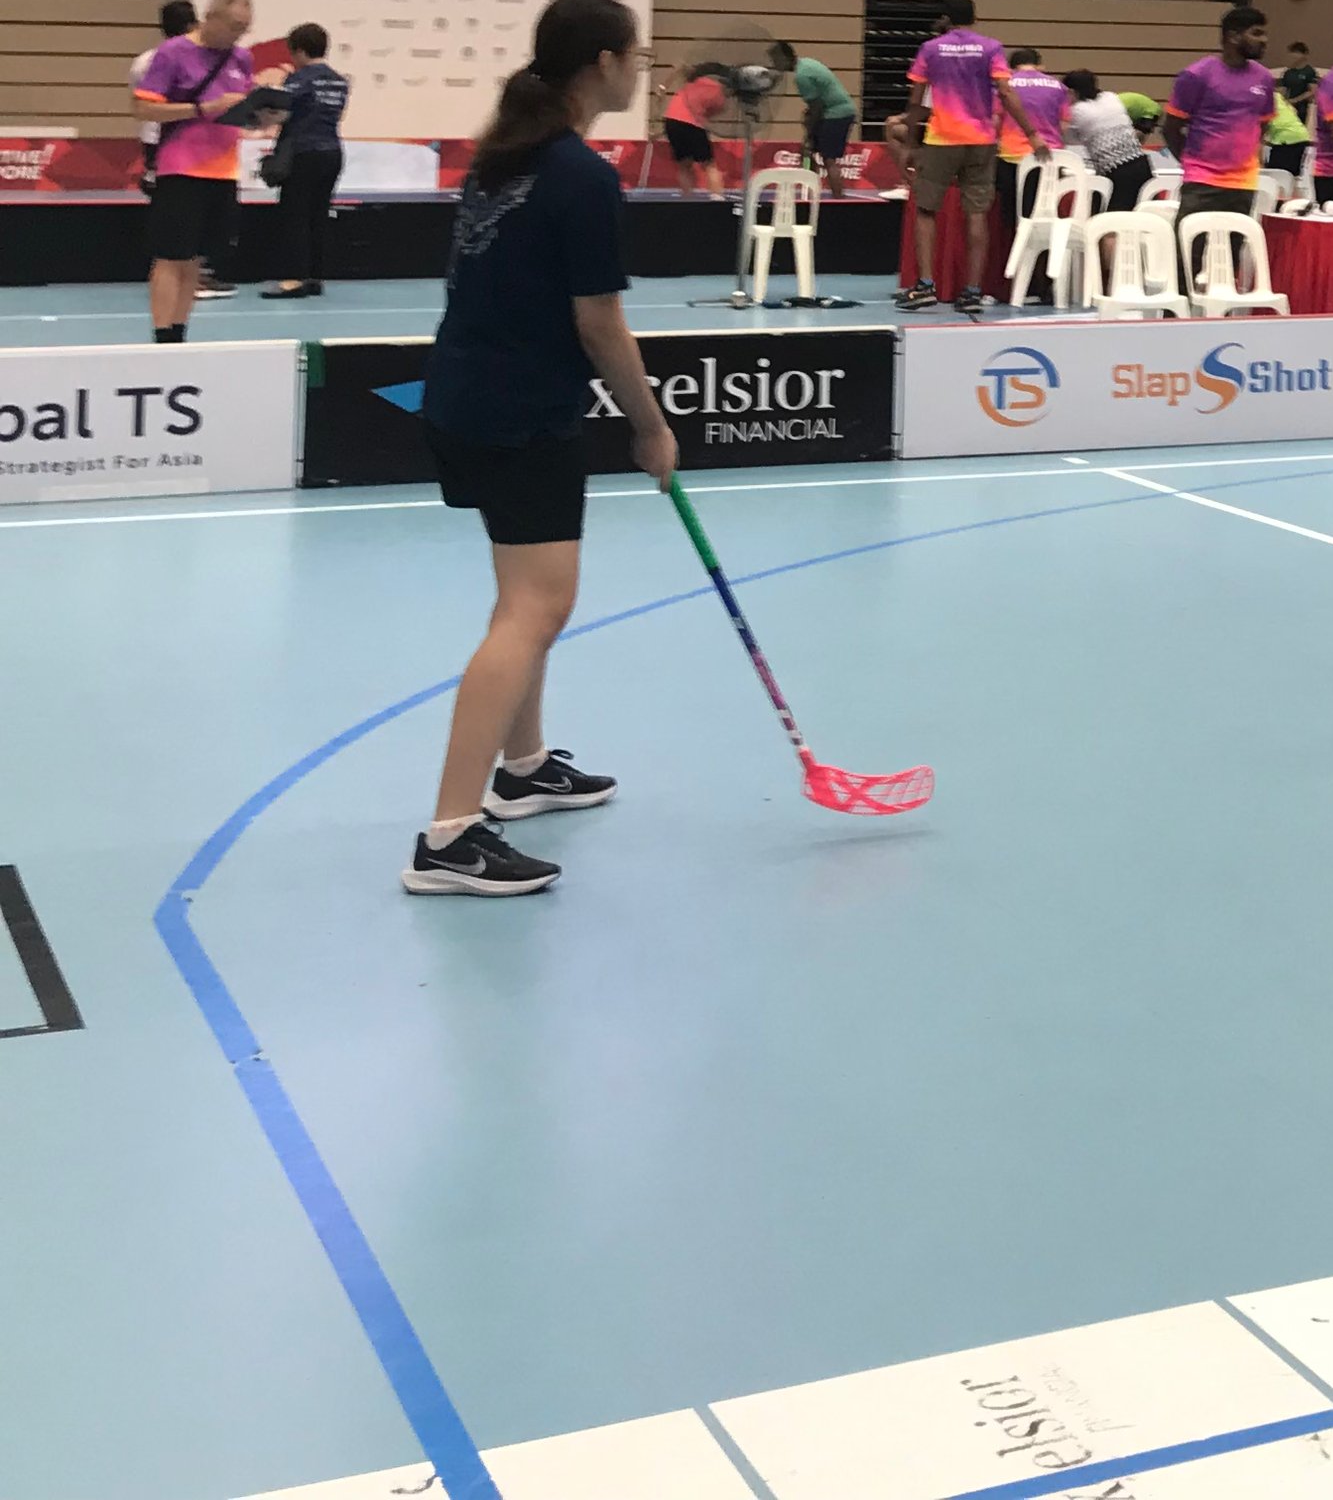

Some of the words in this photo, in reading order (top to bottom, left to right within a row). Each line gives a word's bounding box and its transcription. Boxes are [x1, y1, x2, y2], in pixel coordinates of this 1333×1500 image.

[116, 385, 203, 437] TS
[705, 418, 845, 444] FINANCIAL
[113, 454, 149, 470] For
[157, 452, 203, 467] Asia
